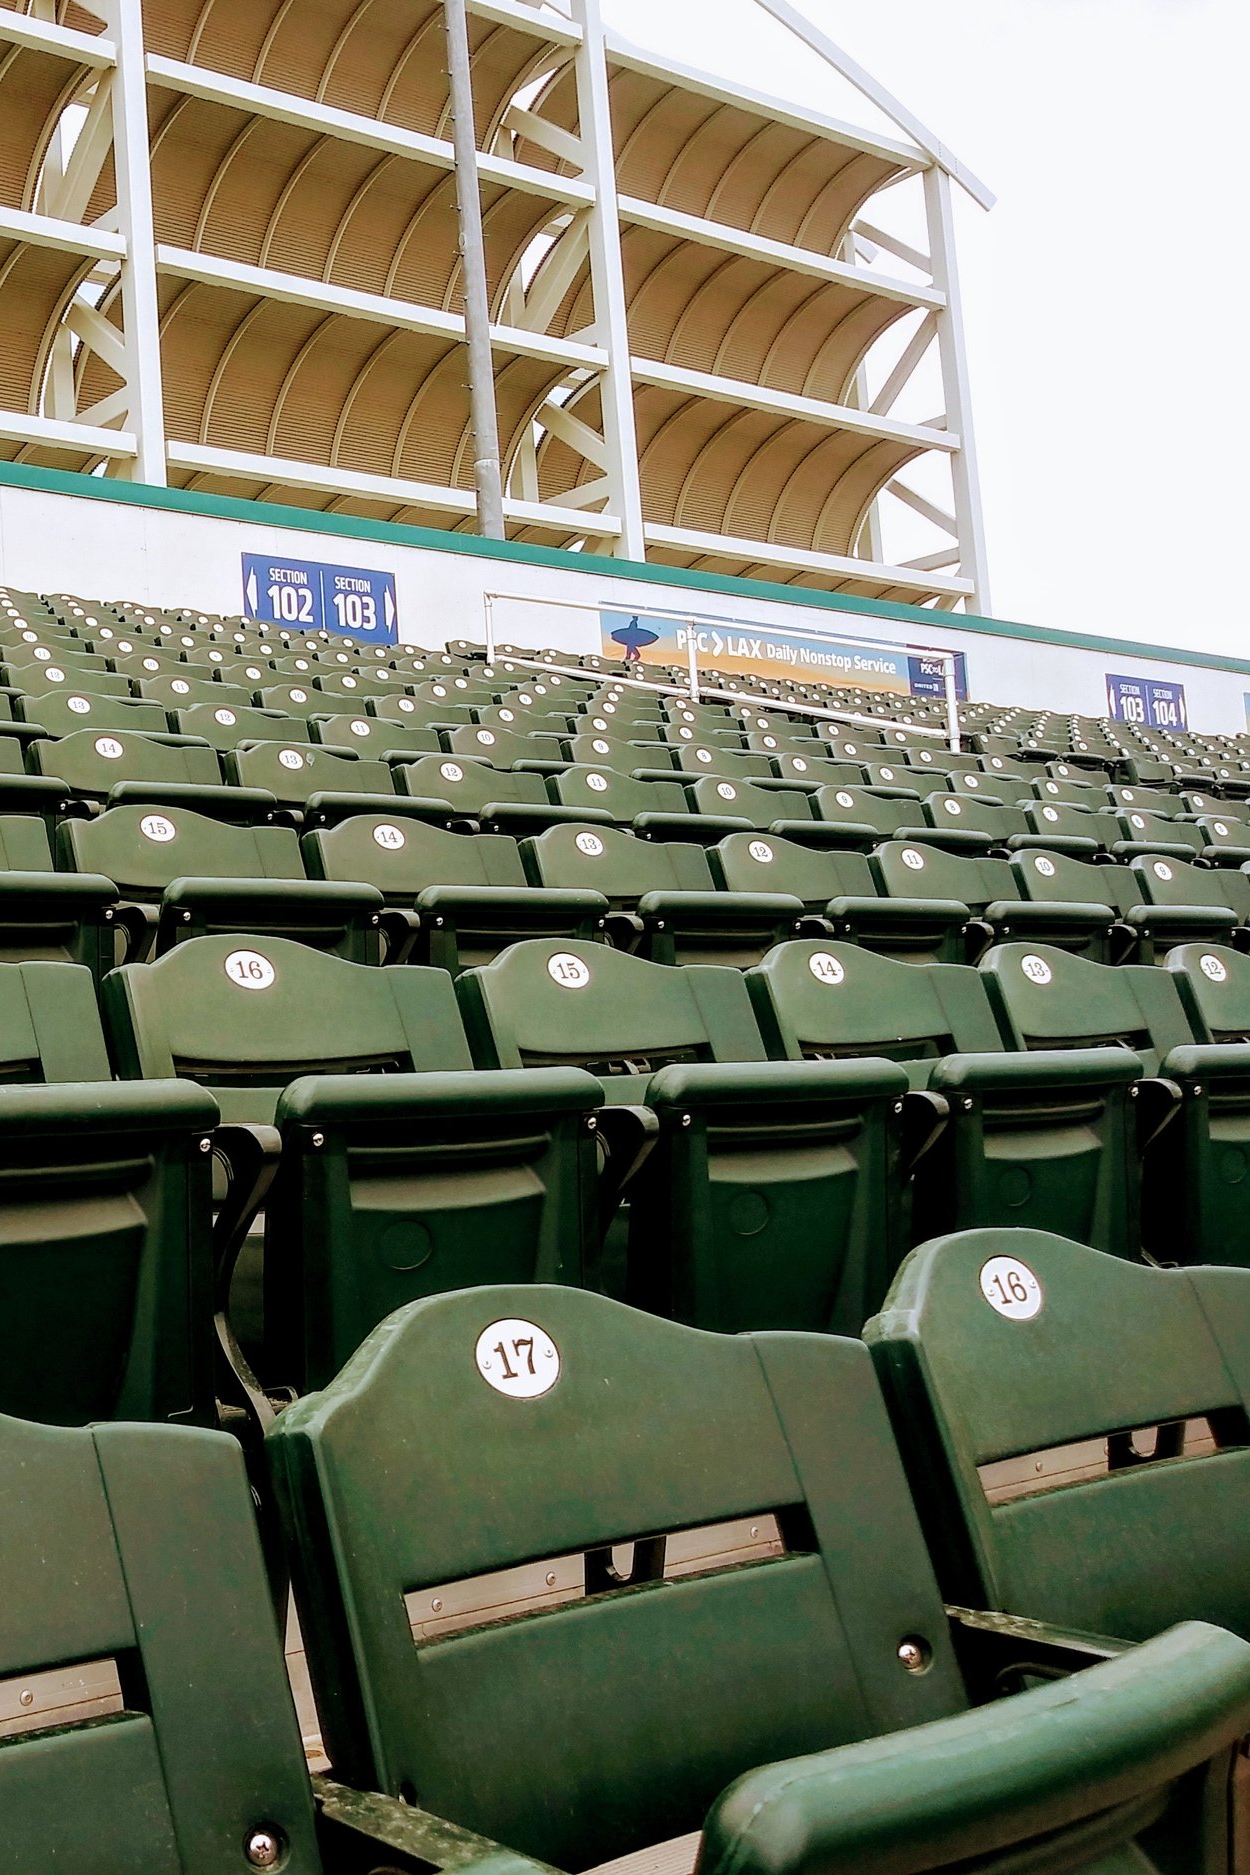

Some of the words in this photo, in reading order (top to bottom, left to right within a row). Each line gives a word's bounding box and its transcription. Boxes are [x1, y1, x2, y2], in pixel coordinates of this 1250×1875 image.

[269, 567, 308, 585] SECTION
[334, 576, 371, 593] SECTION
[267, 585, 314, 623] 102
[332, 593, 377, 630] 103
[727, 636, 763, 660] LAX
[766, 643, 798, 666] Daily
[800, 648, 851, 672] Nonstop
[853, 655, 897, 674] Service
[1120, 695, 1145, 723] 103
[1152, 700, 1177, 726] 104
[101, 743, 117, 754] 14
[284, 754, 298, 765] 13
[445, 767, 459, 778] 12
[591, 777, 603, 787] 11
[148, 821, 168, 835] 15
[380, 831, 399, 844] 14
[581, 838, 598, 850] 13
[753, 846, 769, 858] 12
[906, 854, 920, 865] 11
[1038, 861, 1051, 872] 10
[236, 960, 264, 980] 16
[556, 962, 581, 980] 15
[816, 960, 838, 977] 14
[1027, 961, 1046, 977] 13
[1205, 961, 1222, 975] 12
[993, 1272, 1027, 1304] 16
[494, 1337, 535, 1379] 17
